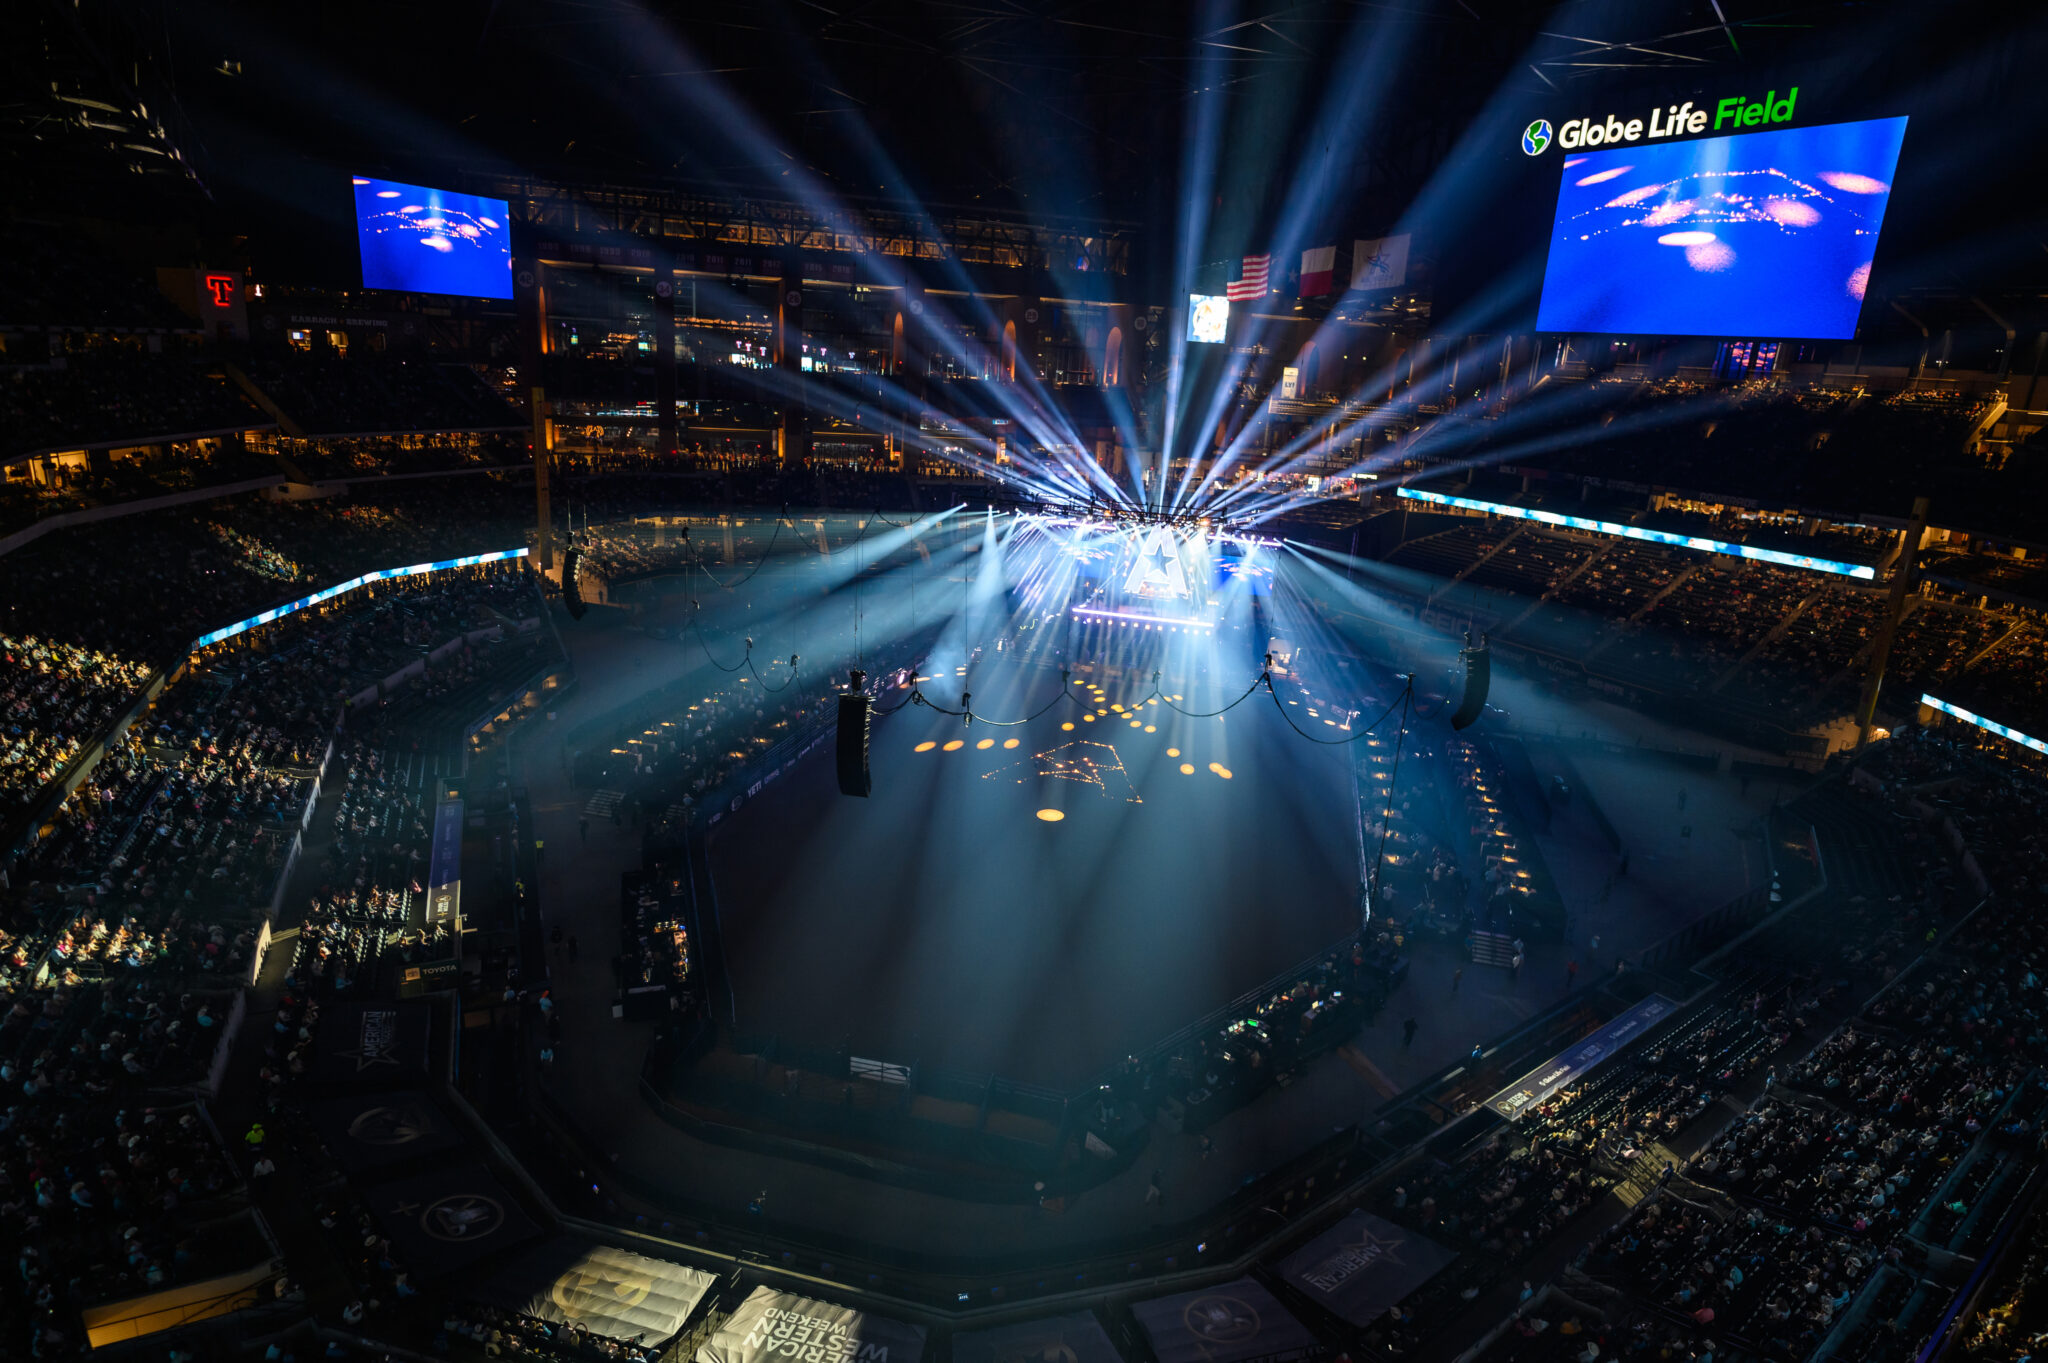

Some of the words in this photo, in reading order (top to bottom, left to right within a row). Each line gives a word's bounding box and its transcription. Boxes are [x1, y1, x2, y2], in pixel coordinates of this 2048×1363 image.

[1558, 114, 1642, 149] Globe
[1648, 102, 1708, 138] Life
[1713, 87, 1799, 131] Field
[346, 318, 388, 328] BREWING
[747, 780, 762, 798] YETI
[422, 964, 457, 975] TOYOTA
[364, 1011, 382, 1057] AMERICAN
[1313, 1243, 1382, 1290] AMERICAN
[753, 1316, 889, 1363] WESTERN
[764, 1307, 847, 1336] WEEKEND
